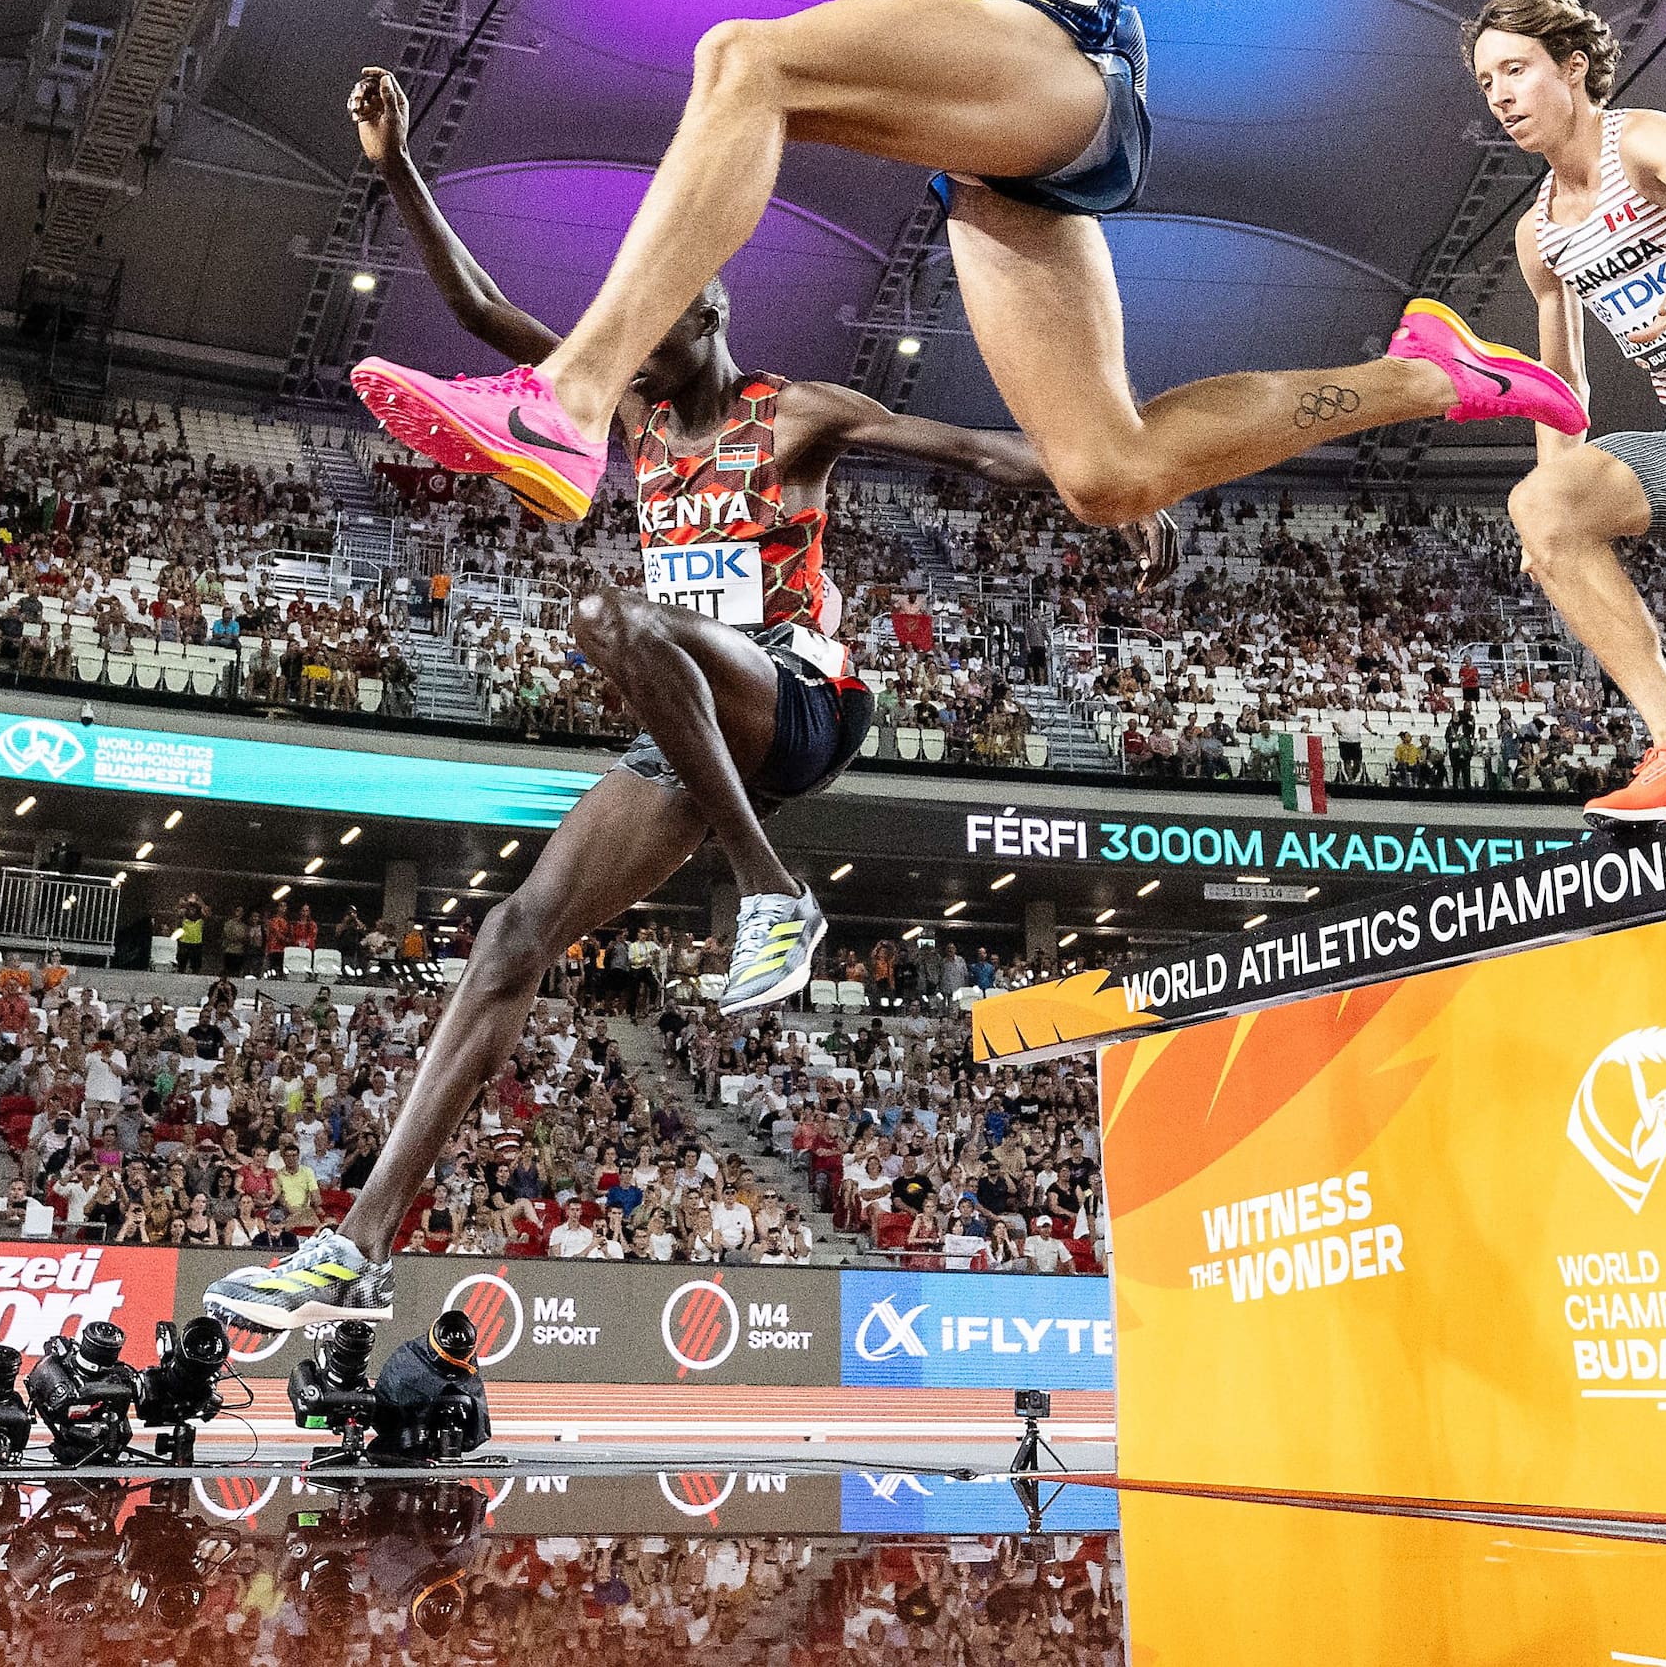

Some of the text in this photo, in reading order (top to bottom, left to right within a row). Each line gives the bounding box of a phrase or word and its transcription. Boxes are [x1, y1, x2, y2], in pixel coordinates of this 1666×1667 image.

[638, 491, 753, 533] KENYA
[661, 548, 749, 581] TDK
[94, 749, 213, 772] CHAMPIONSHIPS
[97, 736, 213, 759] WORLD ATHLETICS
[94, 762, 211, 786] BUDAPEST 23
[967, 806, 1087, 859] FÉRFI
[1100, 822, 1265, 868] 3000M
[1123, 952, 1228, 1014] WORLD
[1237, 903, 1421, 991] ATHLETICS
[1201, 1170, 1373, 1254] WITNESS
[1188, 1223, 1406, 1304] THE WONDER
[1557, 1250, 1660, 1288] WORLD
[533, 1297, 576, 1321] M4
[749, 1303, 790, 1327] M4
[533, 1326, 601, 1345] SPORT
[748, 1331, 813, 1350] SPORT
